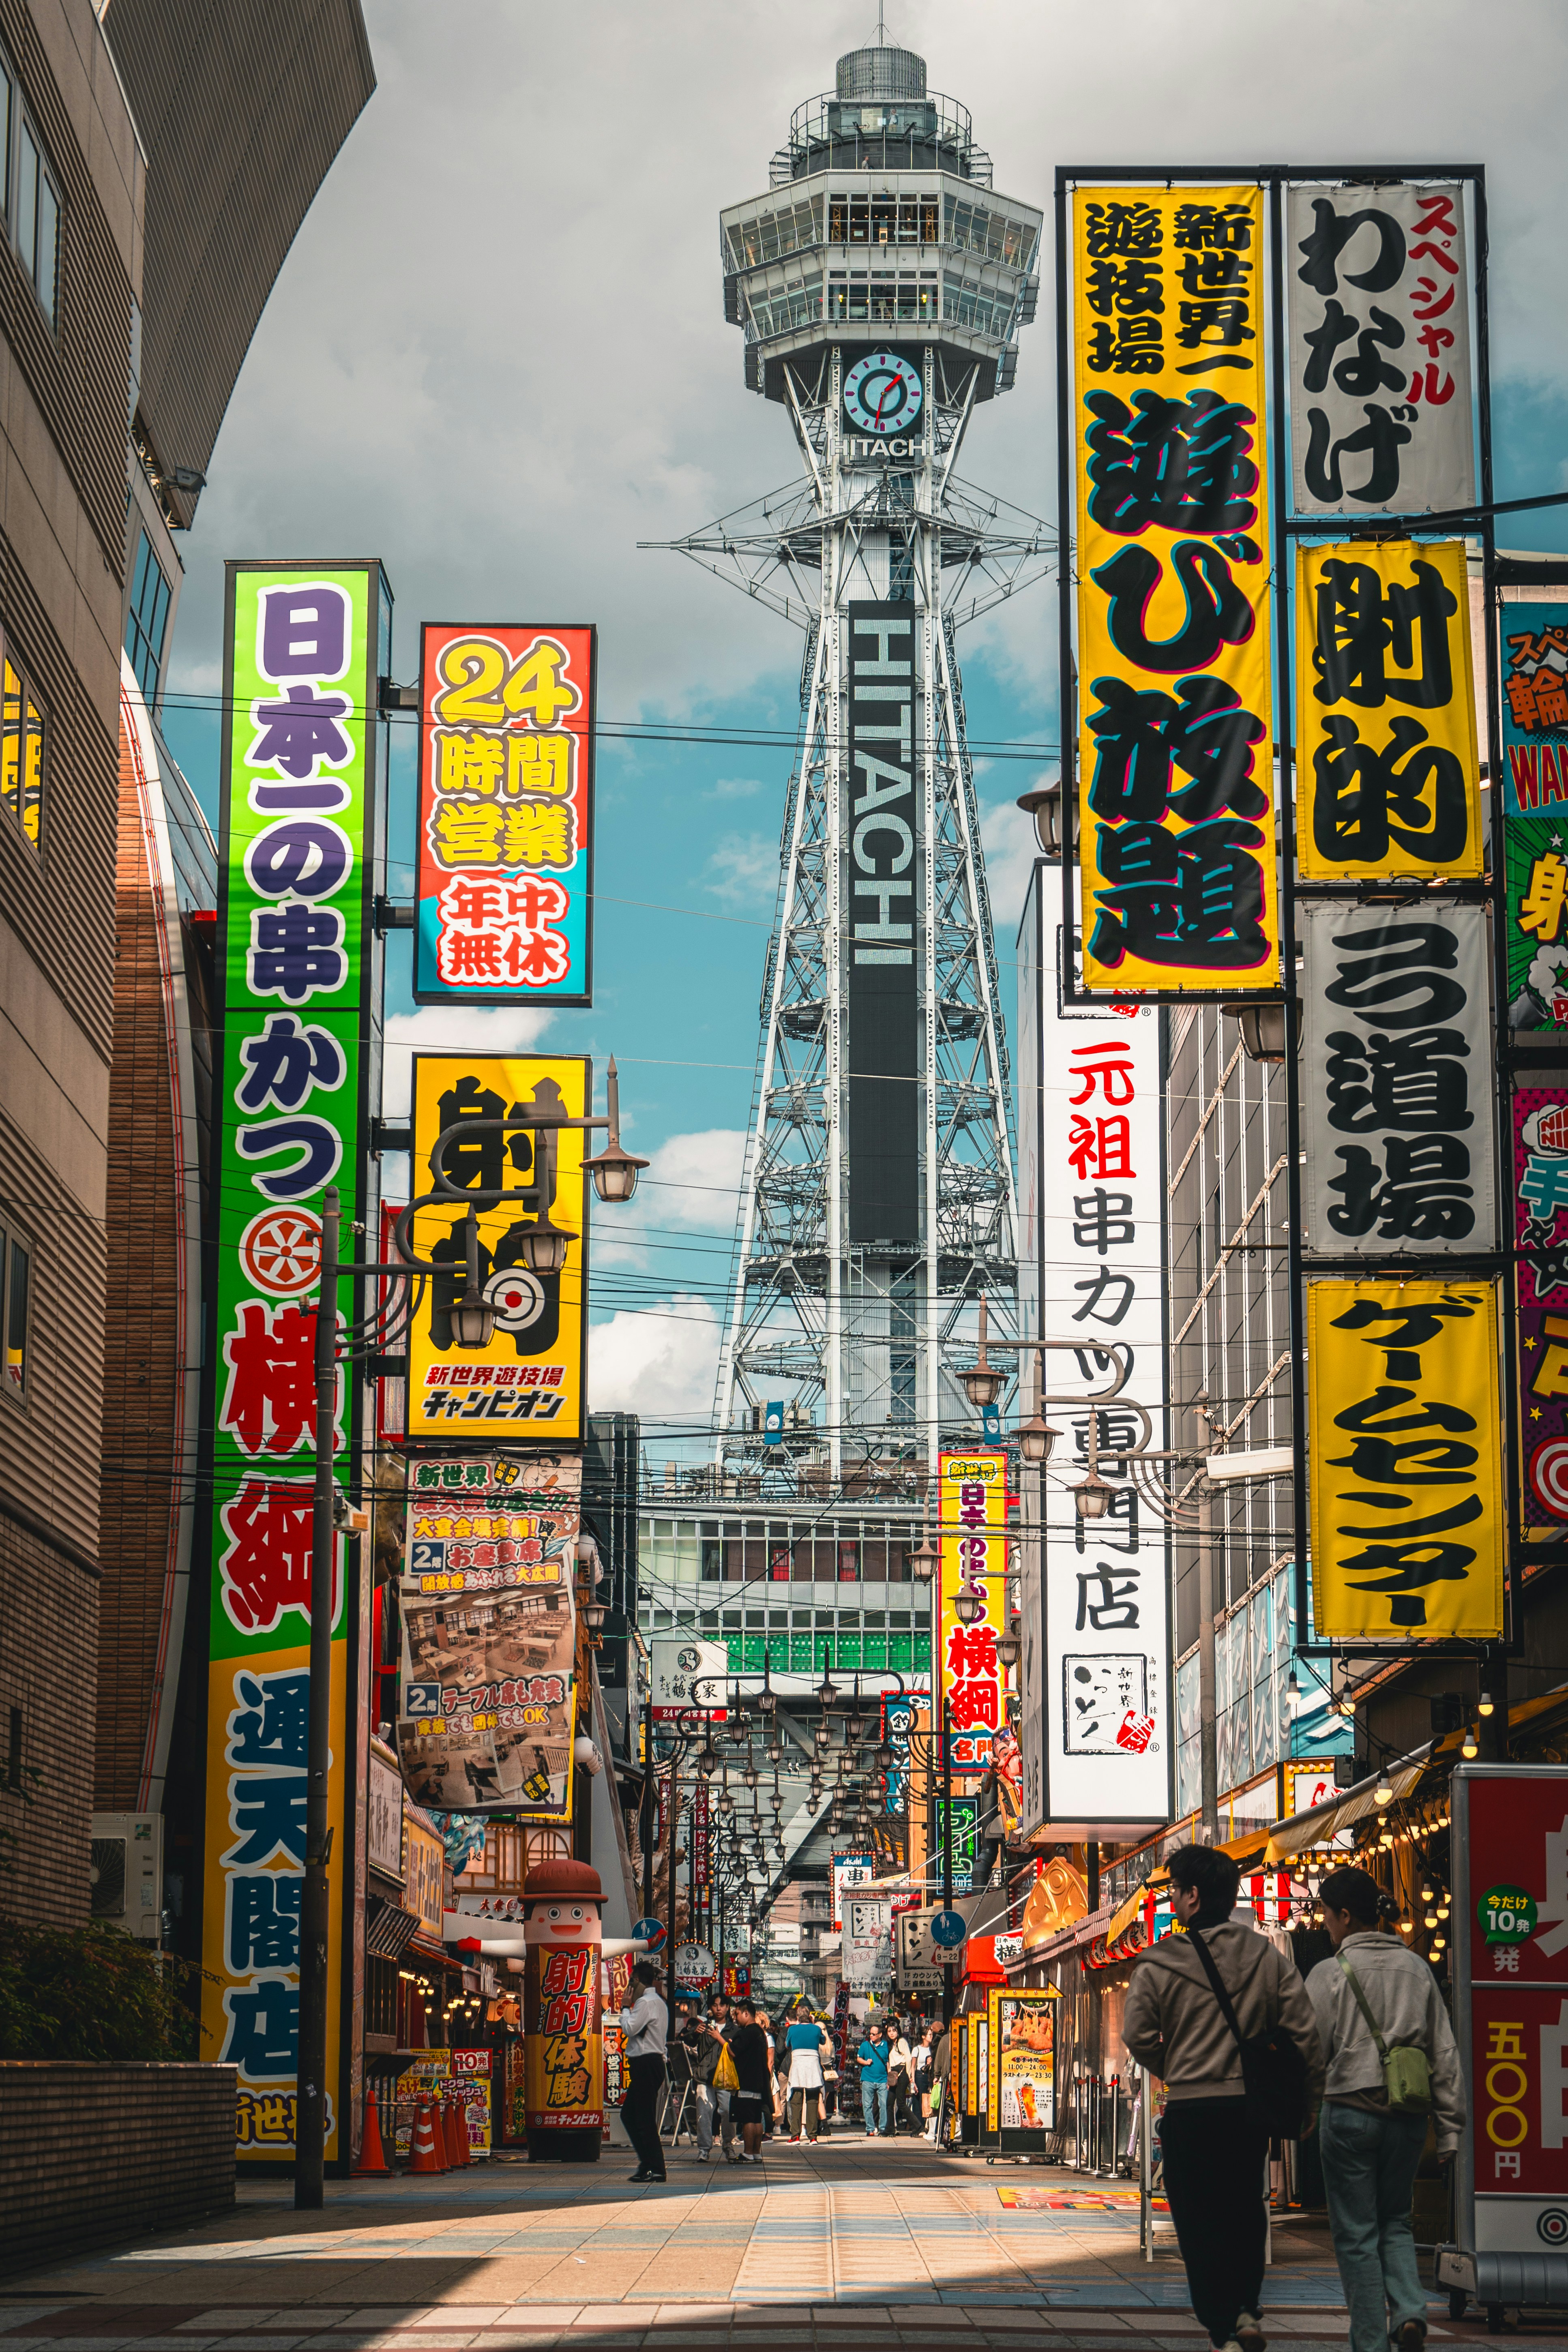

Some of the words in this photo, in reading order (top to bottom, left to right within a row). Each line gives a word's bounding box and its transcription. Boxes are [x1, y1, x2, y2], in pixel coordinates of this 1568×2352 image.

[1084, 202, 1165, 375] 遊技場
[1173, 203, 1256, 376] 新世界一
[1405, 195, 1460, 405] スペシャル
[1297, 197, 1419, 504] わなげ
[830, 438, 935, 457] HITACHI
[1083, 388, 1271, 971] 遊び放題
[1506, 669, 1568, 731] 輪
[1311, 558, 1467, 864] 射的
[853, 619, 913, 964] HITACHI
[239, 582, 351, 1199] 日本一の串かつ
[1324, 922, 1476, 1241] 弓道場
[425, 1364, 566, 1387] 新世界遊技場
[422, 1389, 566, 1419] チャンピオン
[223, 1301, 344, 1631] 横綱
[416, 1464, 488, 1487] 新世界
[1324, 1295, 1484, 1626] ゲームセンター
[414, 1517, 538, 1539] 大宴会場完備!
[448, 1539, 543, 1569] お座敷席
[421, 1564, 560, 1592] 開放感あふれる大広間
[442, 1678, 564, 1713] テーブル席も充実
[947, 1626, 1000, 1732] 横綱
[1118, 1667, 1137, 1708] 新世界
[417, 1707, 547, 1737] 家族でも団体でもOK
[1486, 1910, 1530, 1933] 10発
[1487, 1895, 1529, 1910] 今だけ
[996, 1944, 1021, 1962] 横
[543, 1950, 588, 2105] 射的体験
[439, 2078, 473, 2089] ドクター
[607, 2055, 620, 2103] 営業中
[558, 2113, 600, 2125] チャンピオン
